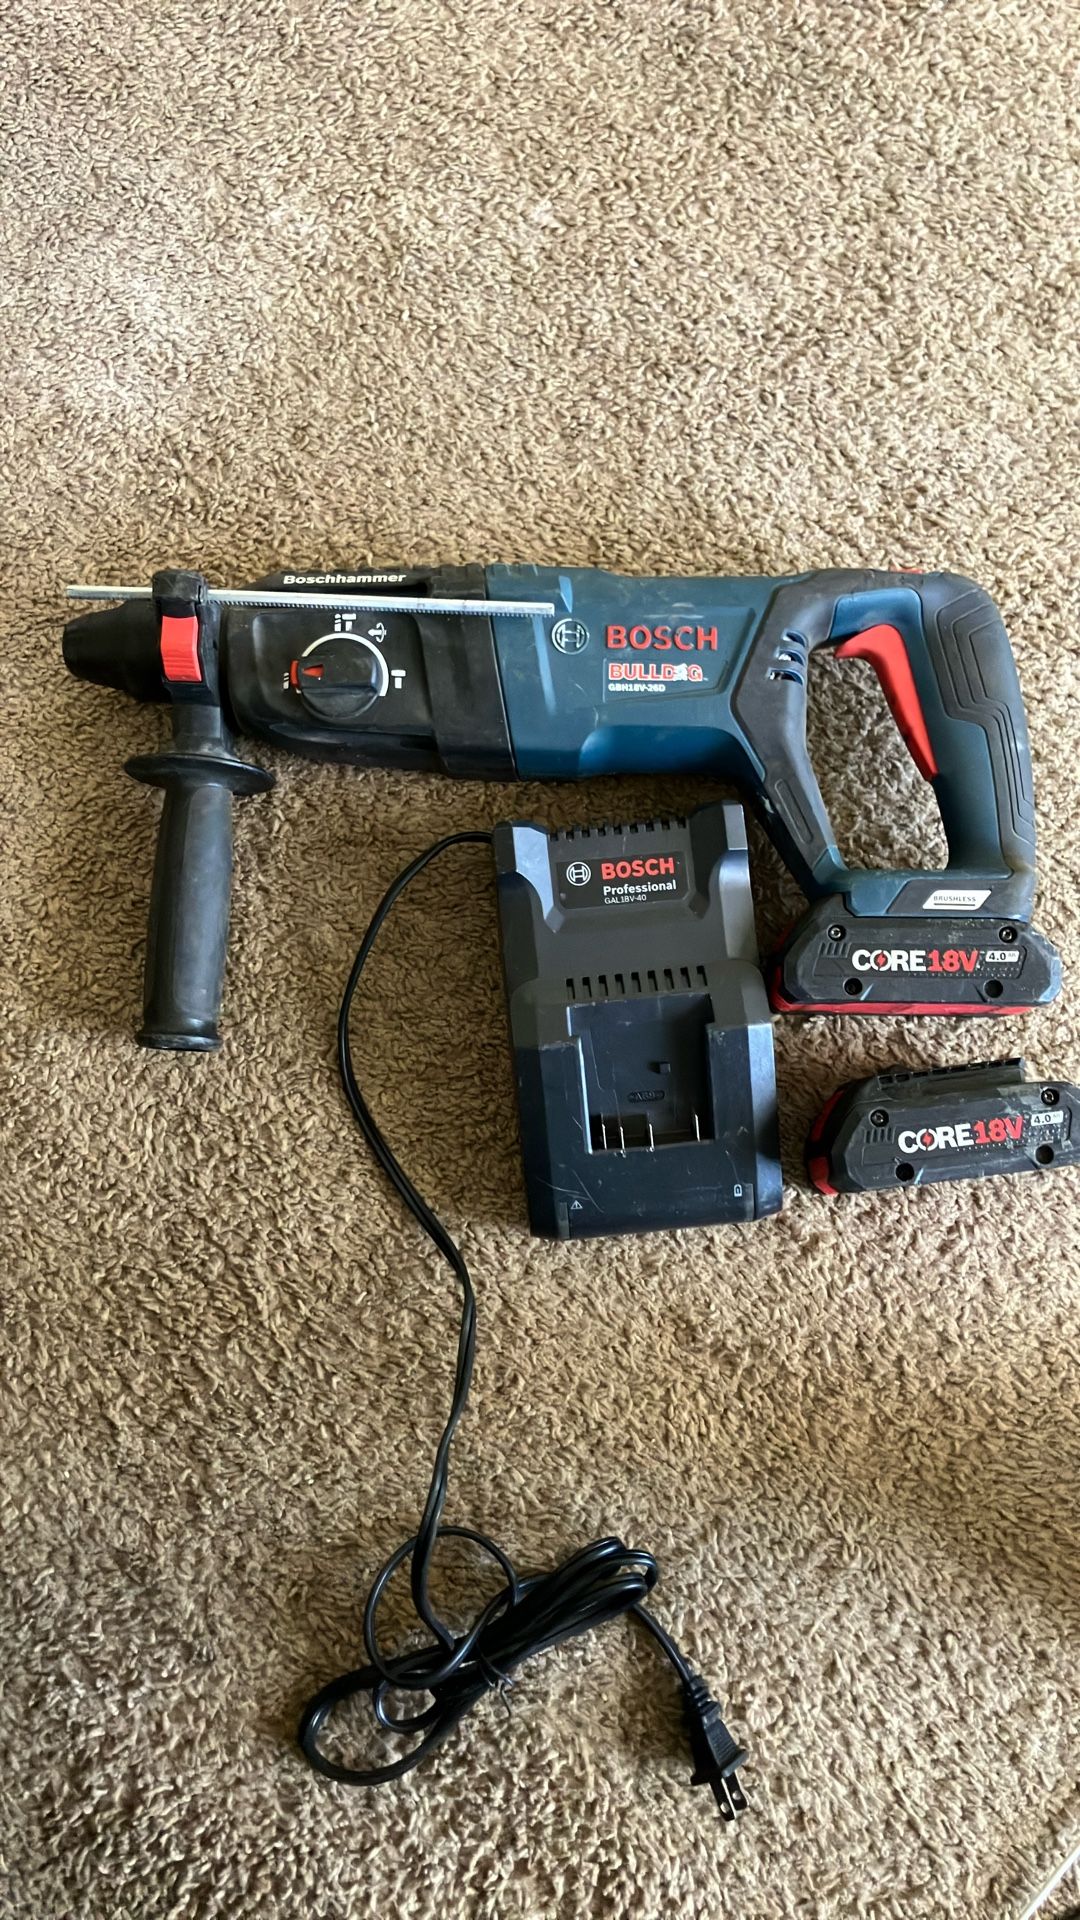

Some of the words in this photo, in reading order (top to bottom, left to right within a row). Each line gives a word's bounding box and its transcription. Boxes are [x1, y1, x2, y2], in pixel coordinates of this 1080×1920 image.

[283, 574, 407, 585] Boschhammer
[606, 624, 718, 651] BOSCH
[608, 662, 703, 681] BULLDG
[608, 683, 666, 692] GBH18V-26D
[601, 857, 675, 880] BOSCH
[603, 879, 677, 896] Professional
[988, 952, 1006, 961] 4.0
[1033, 1114, 1052, 1126] 4.0
